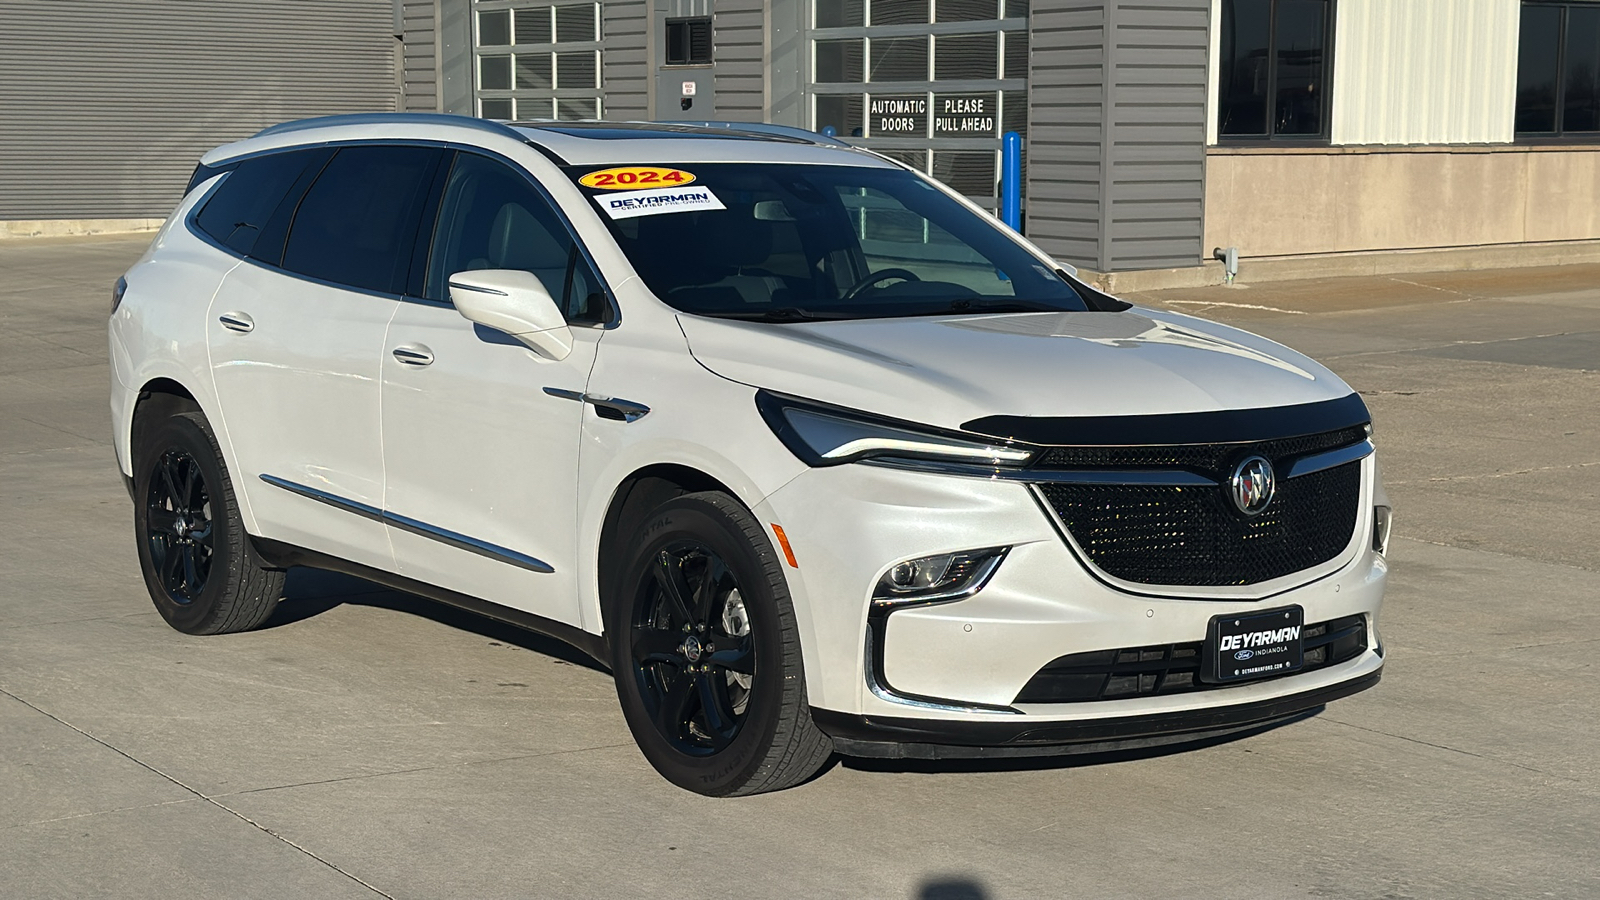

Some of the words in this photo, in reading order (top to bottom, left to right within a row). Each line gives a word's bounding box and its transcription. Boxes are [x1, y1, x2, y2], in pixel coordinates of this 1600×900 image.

[871, 100, 925, 114] AUTOMATIC
[945, 99, 984, 113] PLEASE
[881, 117, 915, 131] DOORS
[936, 117, 958, 131] PULL
[961, 117, 993, 131] AHEAD
[594, 171, 685, 187] 2024
[610, 193, 708, 208] DEYARMAN
[621, 202, 663, 211] CERTIFIED
[1220, 626, 1300, 651] DEYARMAN
[1255, 646, 1288, 656] INDIANOLA
